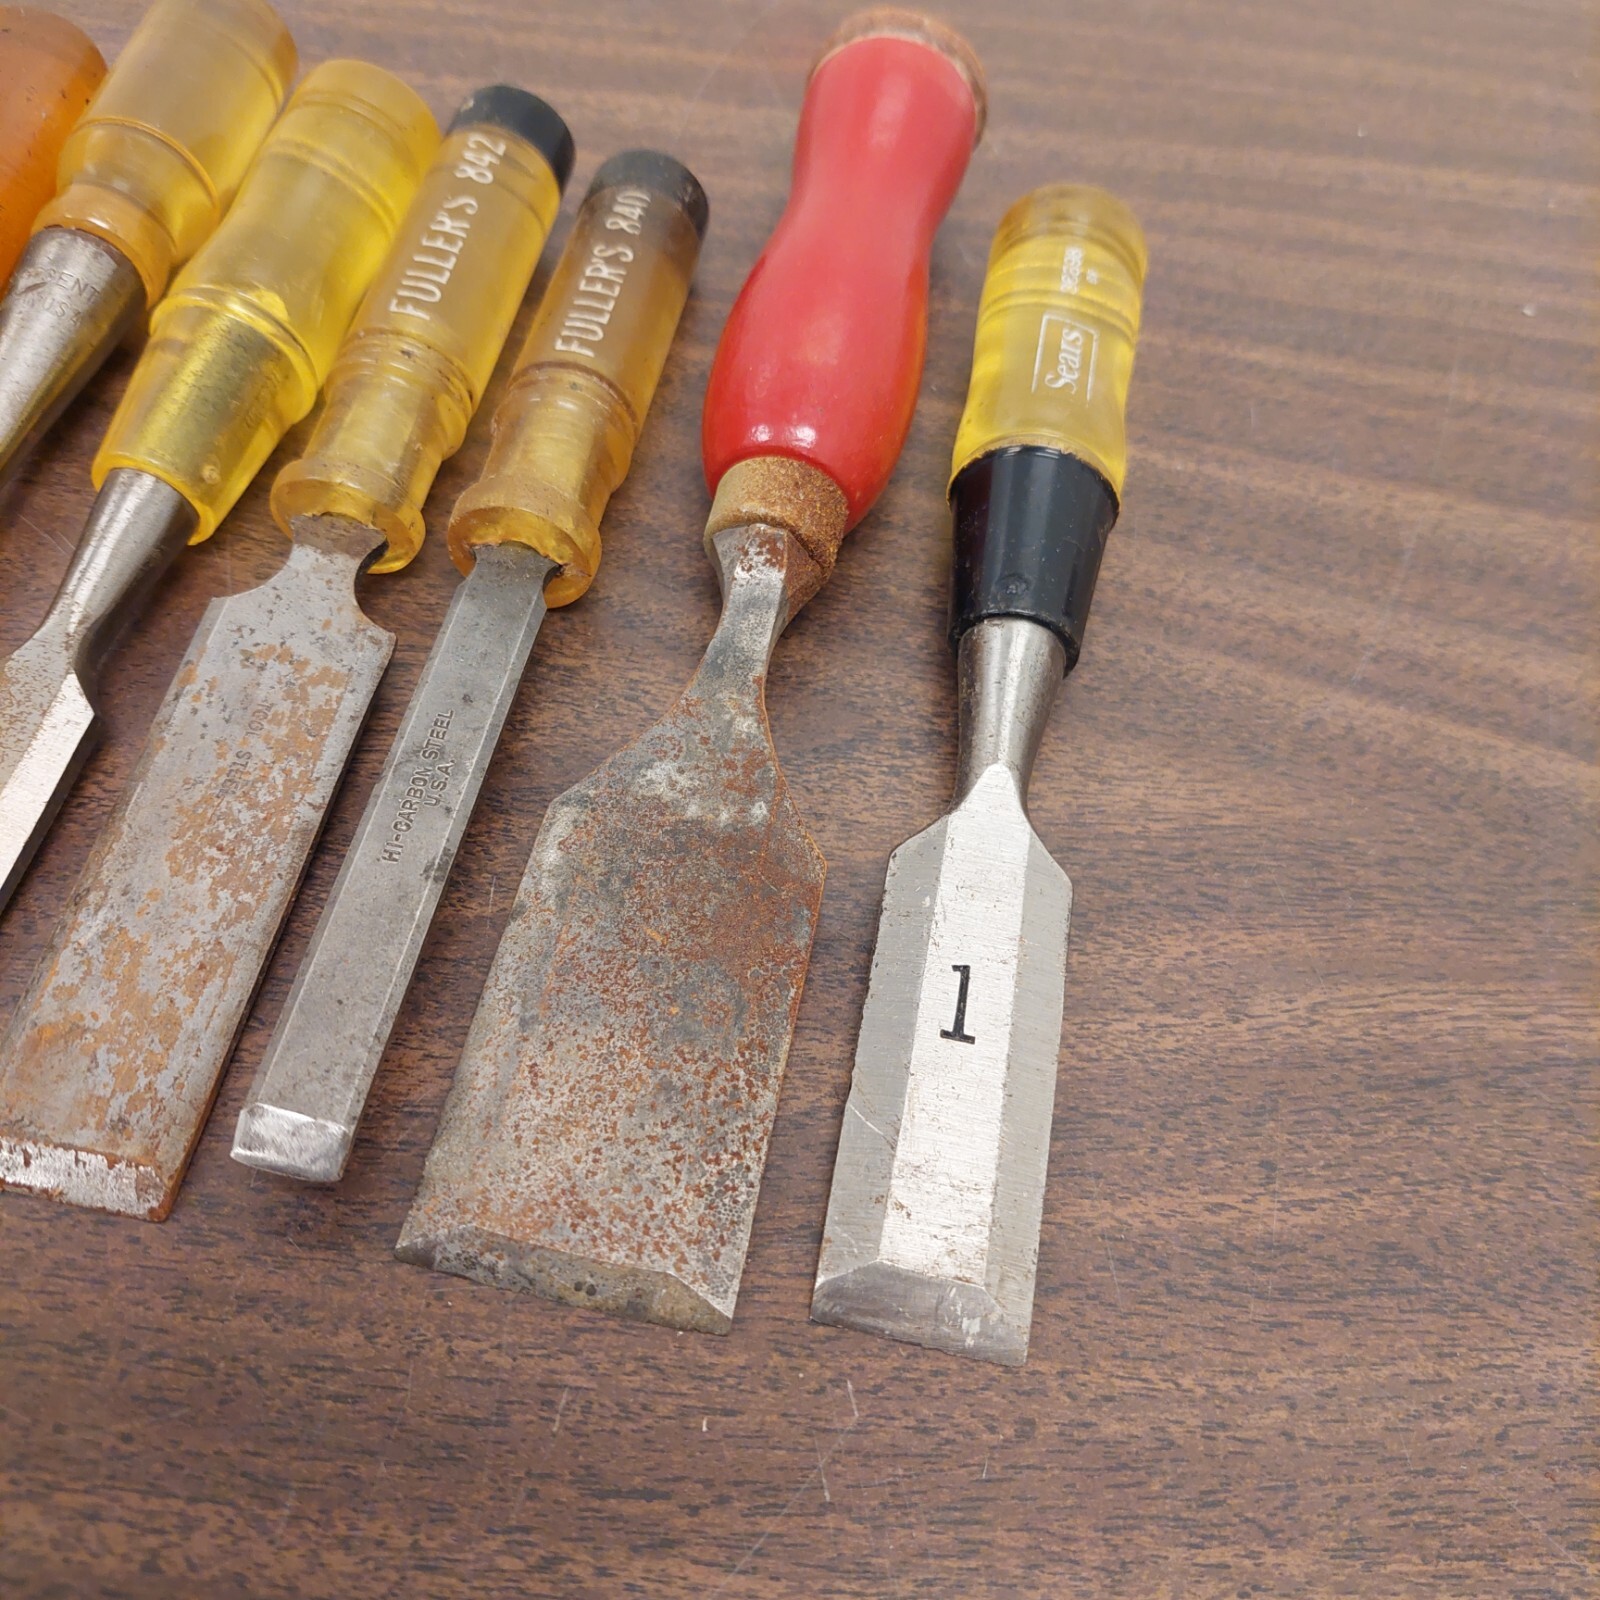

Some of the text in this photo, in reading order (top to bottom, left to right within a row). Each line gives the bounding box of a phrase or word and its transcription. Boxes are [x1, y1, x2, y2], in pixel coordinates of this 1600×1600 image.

[388, 133, 507, 321] FULLER'S 842
[554, 190, 651, 358] FULLER'S 840
[1044, 327, 1084, 395] Sears
[381, 709, 455, 864] HI-CARBON STEEL
[423, 759, 456, 807] U.S.A.
[940, 965, 976, 1045] 1
